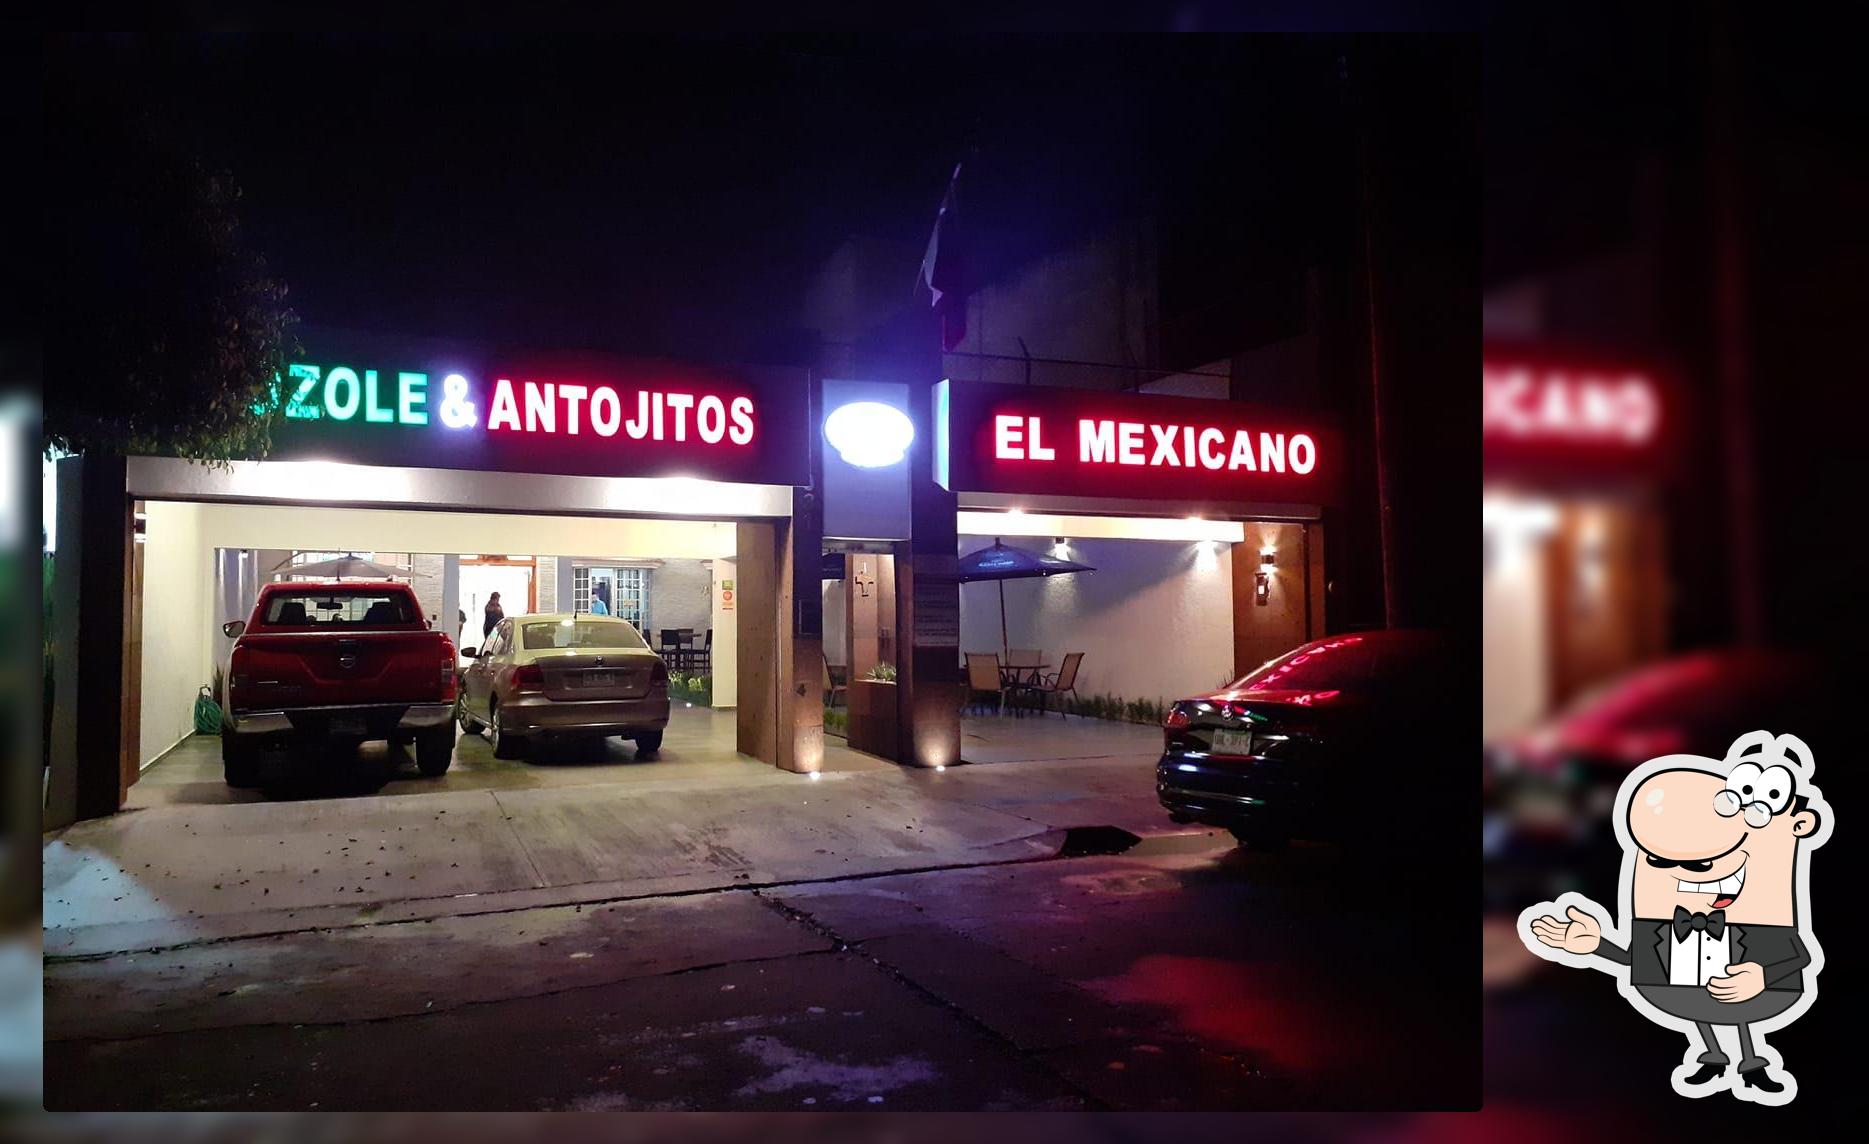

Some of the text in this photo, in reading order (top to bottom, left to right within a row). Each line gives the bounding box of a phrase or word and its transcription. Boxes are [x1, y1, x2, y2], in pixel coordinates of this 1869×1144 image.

[440, 374, 478, 428] &
[487, 379, 755, 446] ANTOJITOS
[994, 414, 1317, 475] EL MEXICANO
